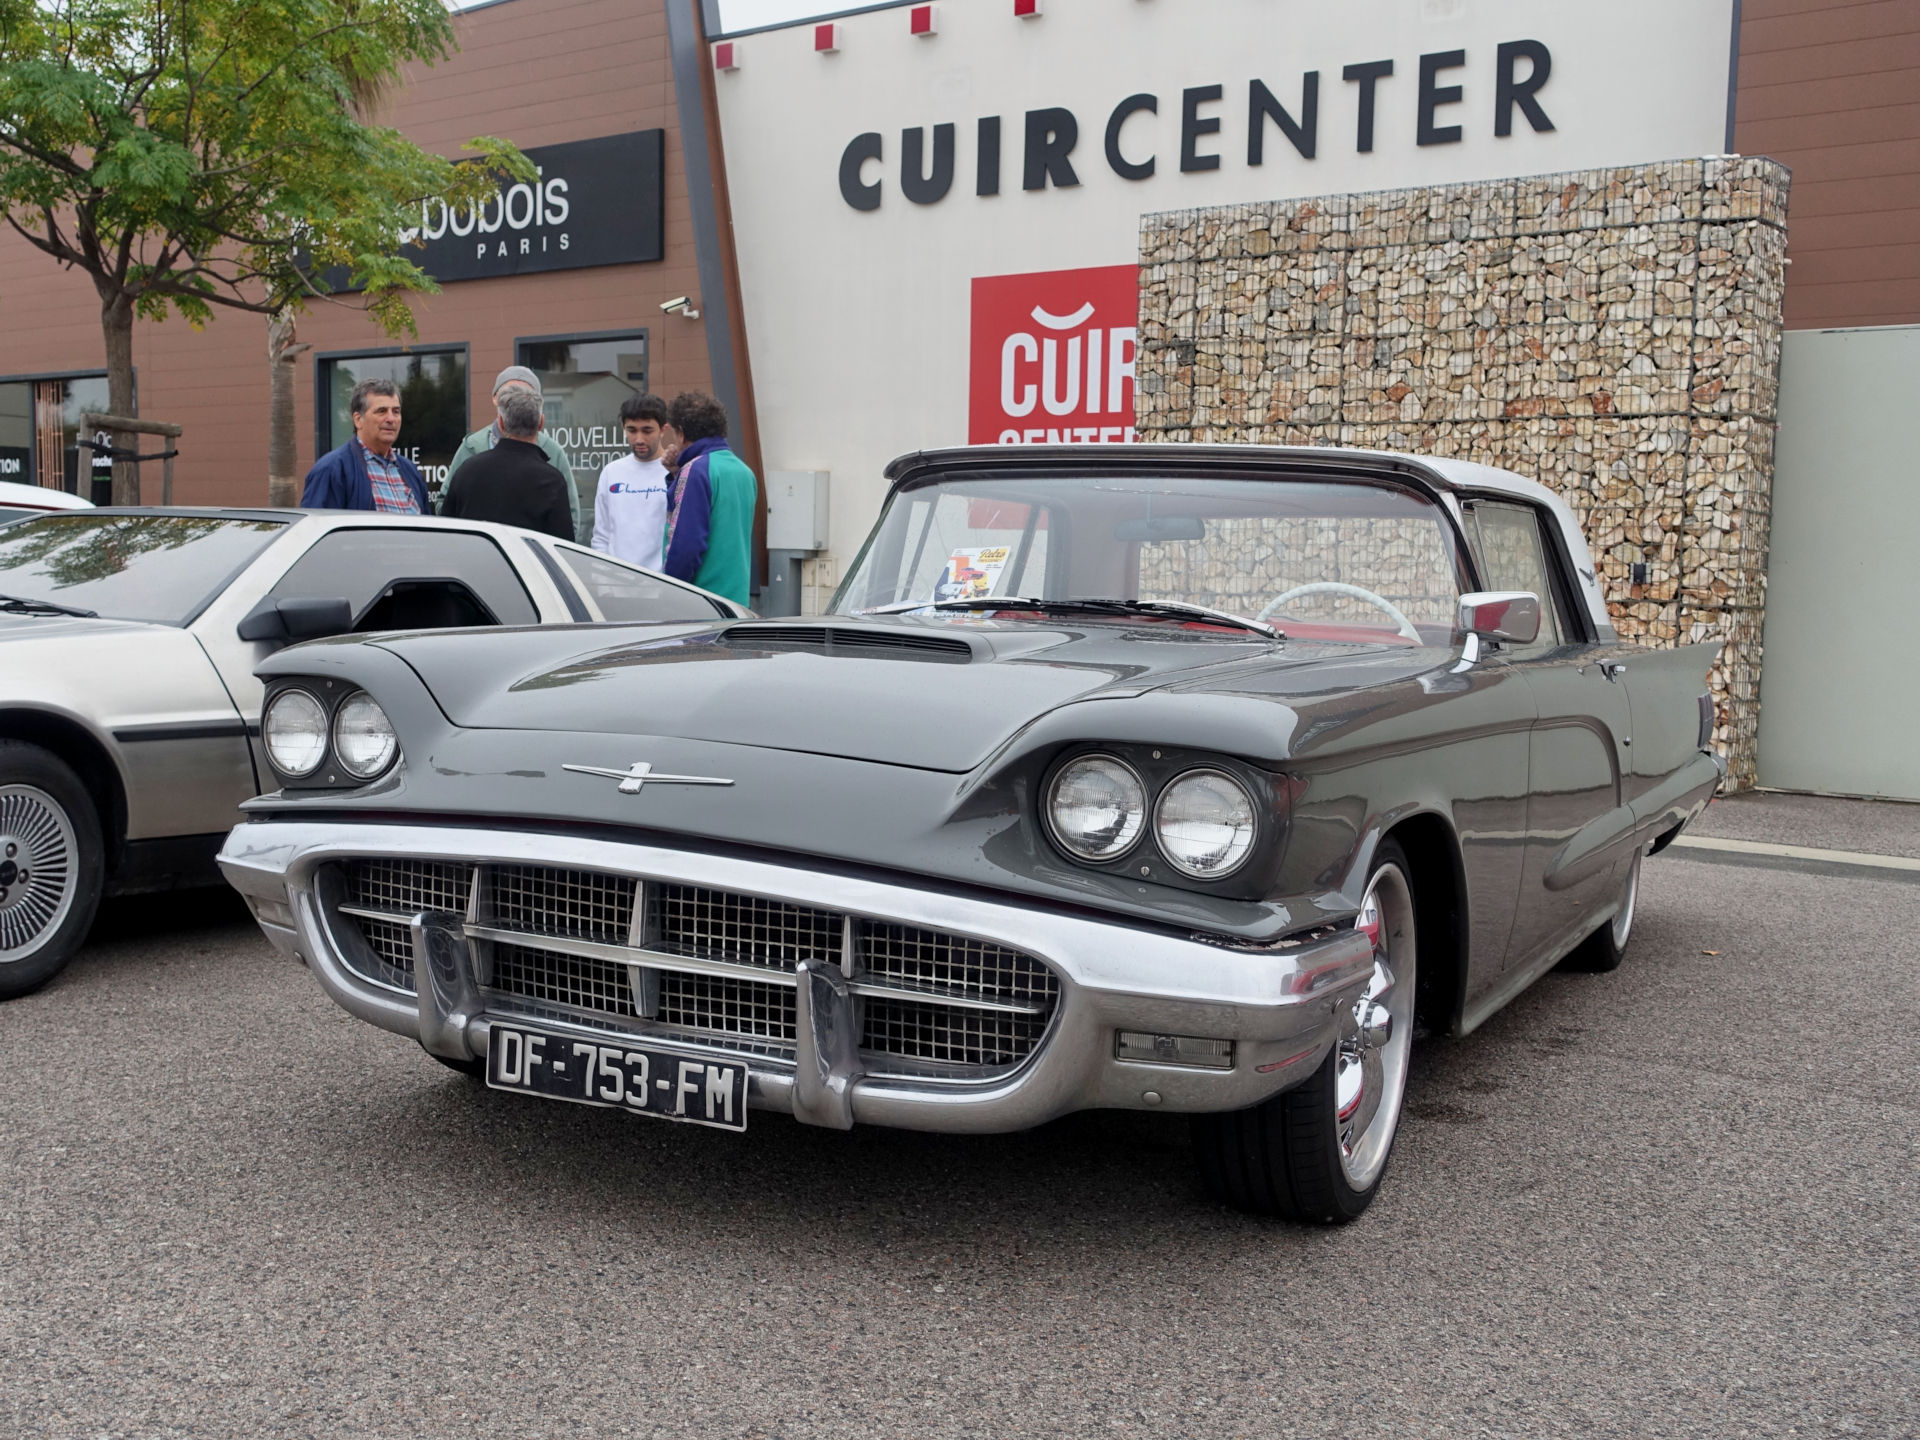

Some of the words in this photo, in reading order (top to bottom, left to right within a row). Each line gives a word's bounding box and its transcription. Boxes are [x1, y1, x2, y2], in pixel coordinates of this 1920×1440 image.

[477, 233, 569, 259] PARIS
[1001, 327, 1136, 417] CUIR
[609, 482, 669, 499] Champion
[497, 1029, 734, 1122] DF-753-FM
